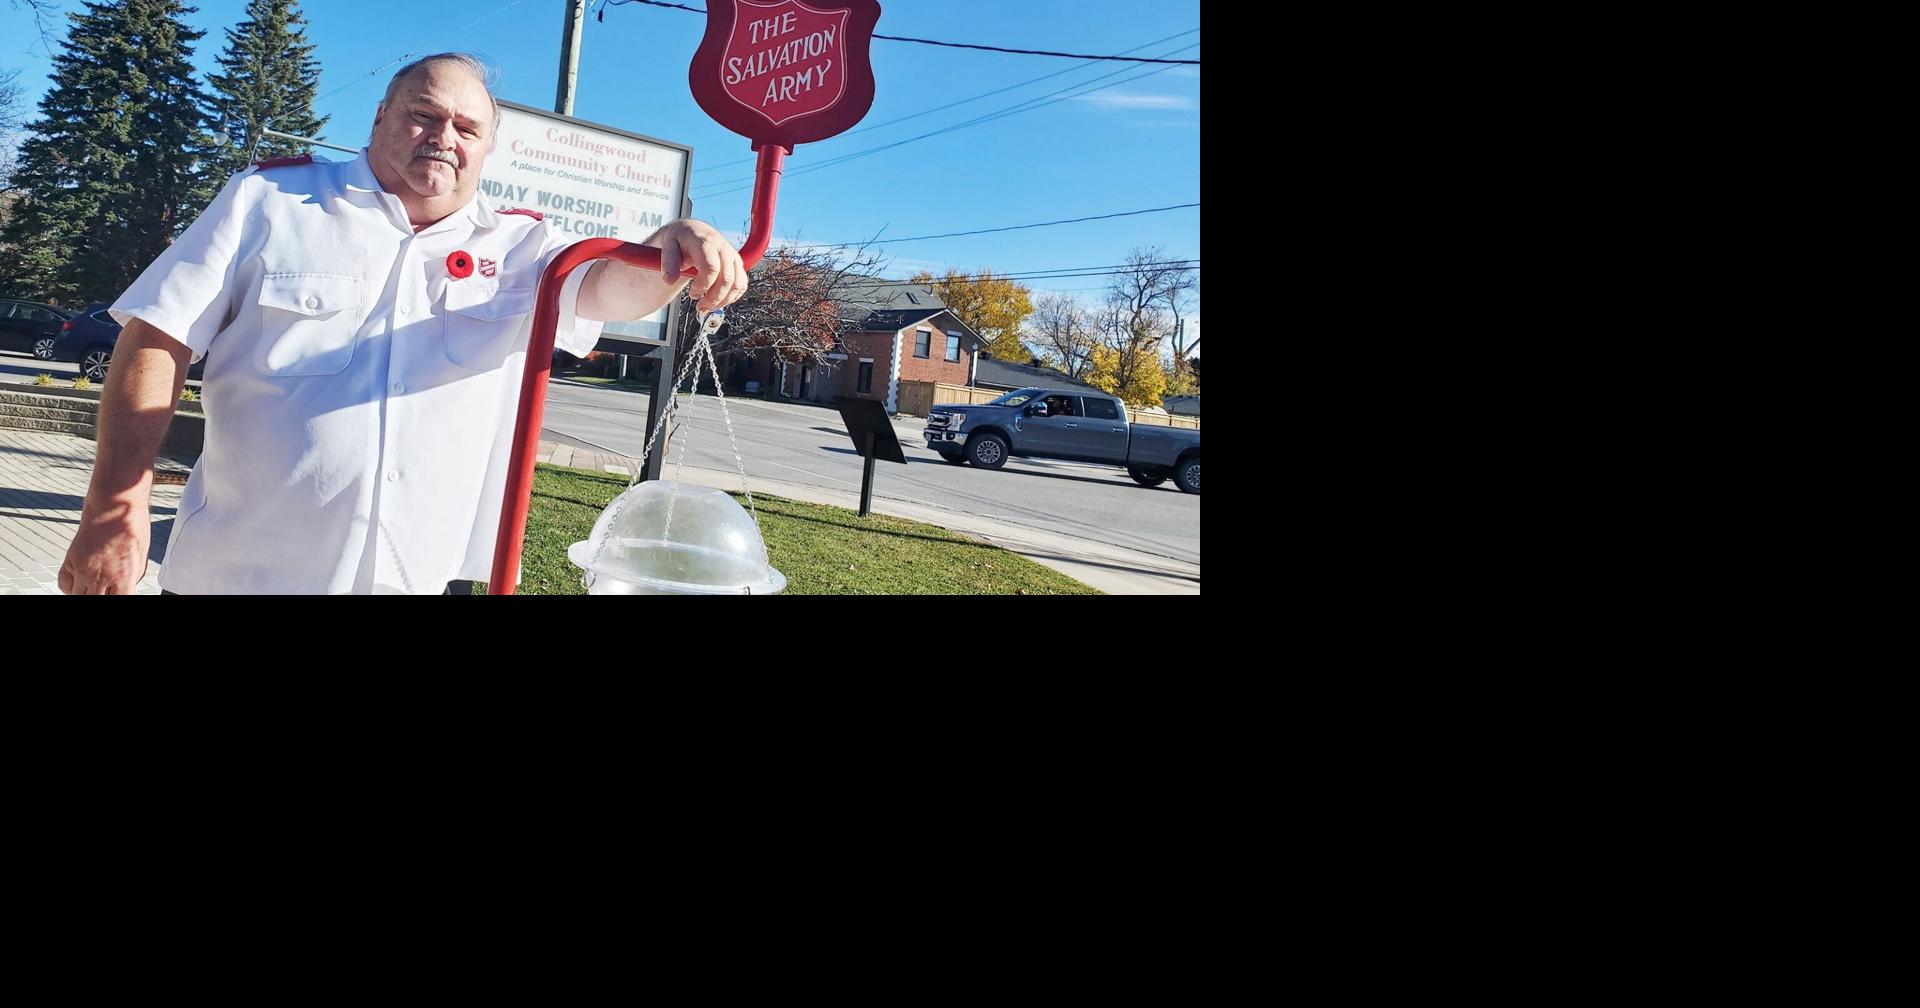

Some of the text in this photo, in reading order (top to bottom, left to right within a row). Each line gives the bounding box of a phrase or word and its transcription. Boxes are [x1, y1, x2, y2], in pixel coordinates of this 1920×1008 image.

[749, 11, 797, 45] THE
[726, 24, 836, 85] SALVATION
[762, 59, 832, 107] ARMY
[511, 139, 672, 188] Community Church
[546, 127, 647, 164] Collingwood
[477, 178, 529, 202] NDAY
[537, 190, 614, 219] WORSHIP
[639, 211, 663, 229] AM
[510, 160, 670, 201] A place for Christian Worship and Service
